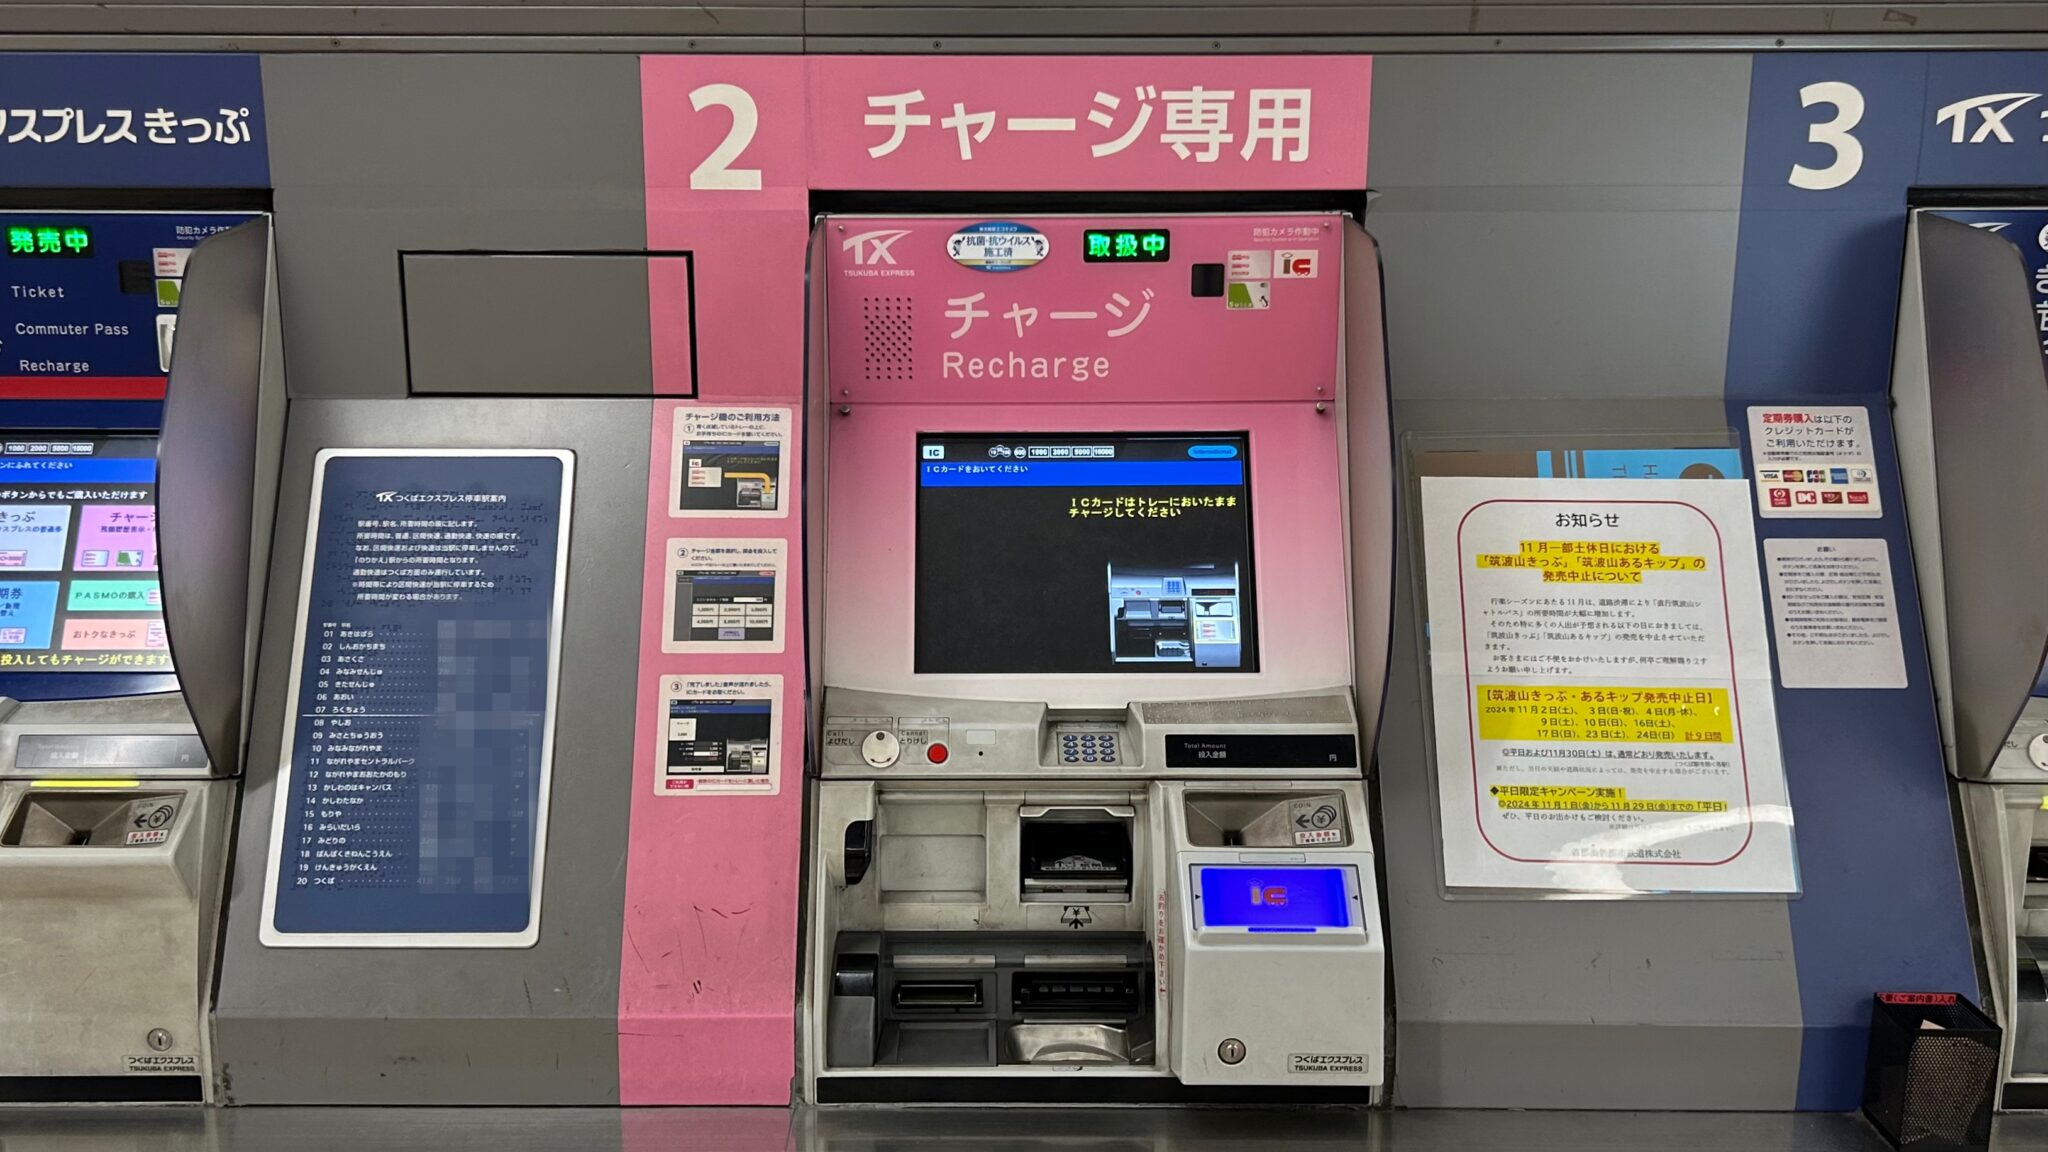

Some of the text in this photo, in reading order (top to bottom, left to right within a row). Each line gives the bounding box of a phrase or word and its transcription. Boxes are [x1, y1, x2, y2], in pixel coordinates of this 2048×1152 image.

[143, 107, 251, 144] きっぷ
[863, 85, 1312, 162] チャージ専用
[688, 83, 762, 190] 2
[1788, 81, 1865, 190] 3
[9, 226, 89, 254] 発売中
[1088, 232, 1166, 257] 取扱中
[983, 247, 1013, 257] 施工済
[11, 285, 65, 298] Ticket
[944, 287, 1155, 340] チャージ
[15, 323, 129, 335] Commuter Pass
[19, 360, 90, 372] Recharge
[943, 351, 1110, 382] Recharge
[1762, 413, 1853, 424] 定期券購入は以下の
[1764, 426, 1854, 436] クレジットカードが
[1766, 439, 1860, 448] ご利用いただけます。
[929, 449, 940, 457] IC
[926, 464, 1028, 473] ICカードをおいてください
[1071, 496, 1236, 508] ICカードはトレーにおいたまま
[1797, 492, 1816, 503] DC
[1069, 507, 1181, 518] チャージしてください
[1555, 513, 1620, 528] お知らせ
[1542, 571, 1642, 583] 発売中止について
[73, 630, 136, 639] おトクなきっぷ
[827, 737, 855, 745] よびだし
[900, 737, 927, 745] とりけし
[1198, 751, 1227, 759] 投入金額
[1329, 754, 1337, 762] 円
[297, 877, 307, 885] 20
[128, 1056, 195, 1065] つくばエクスプレス
[1294, 1056, 1363, 1064] つくばエクスプレス
